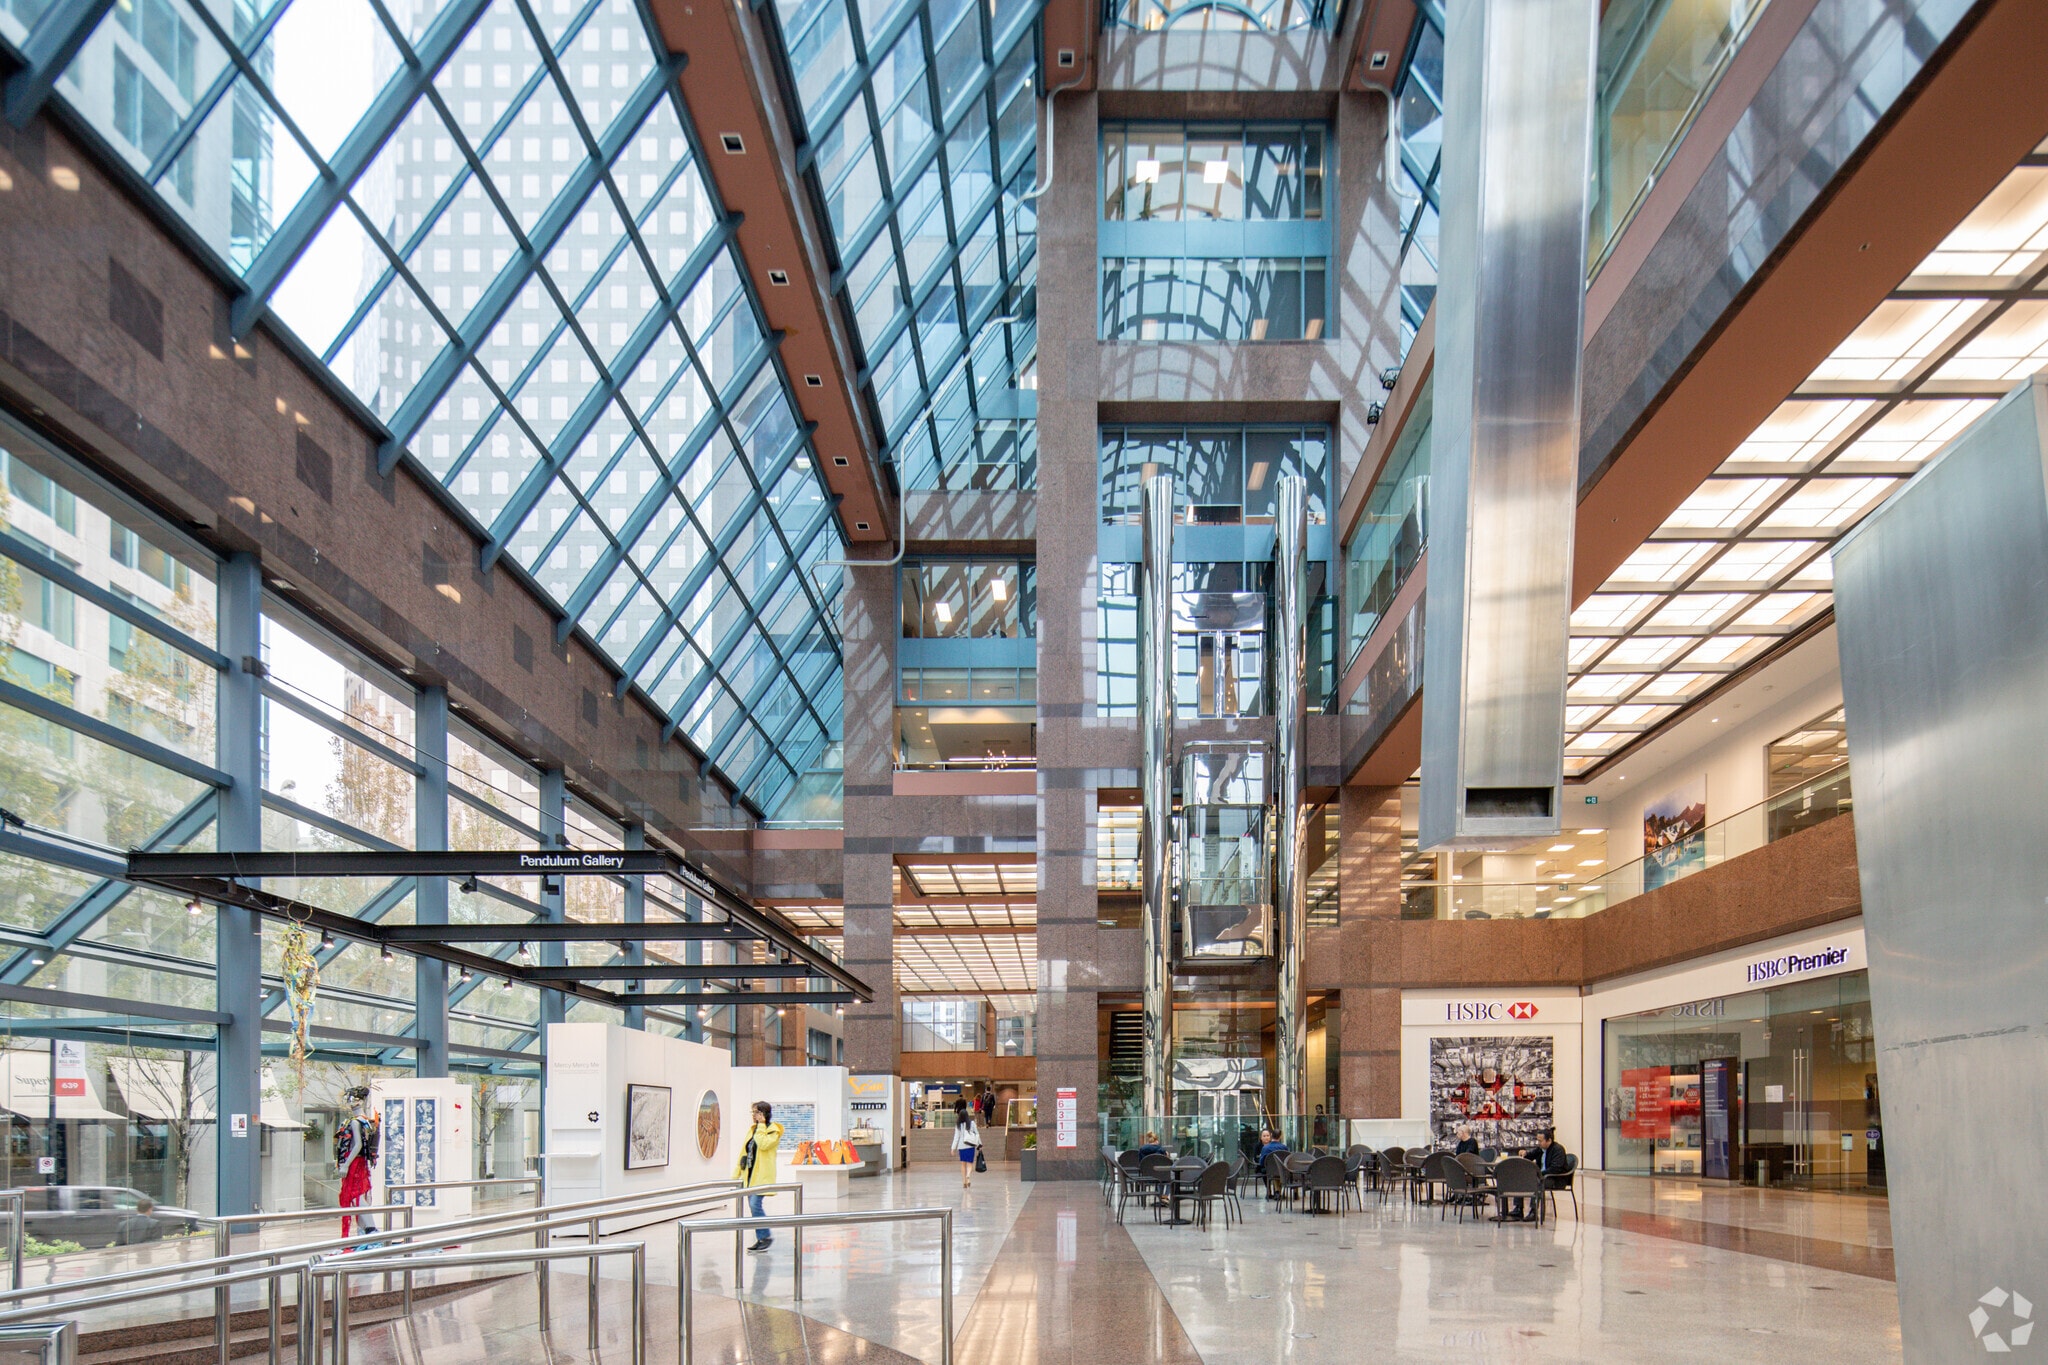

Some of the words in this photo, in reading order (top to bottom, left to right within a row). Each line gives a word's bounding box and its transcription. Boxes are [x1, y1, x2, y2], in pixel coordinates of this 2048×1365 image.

[520, 854, 580, 867] Pendulum
[582, 854, 624, 868] Gallery
[1747, 958, 1788, 982] HSBC
[1788, 947, 1848, 973] Premier
[1446, 1002, 1503, 1021] HSBC
[61, 1082, 79, 1090] 639
[1058, 1100, 1065, 1108] 6
[1058, 1111, 1065, 1119] 3
[1059, 1122, 1064, 1130] 1
[1058, 1132, 1065, 1141] C
